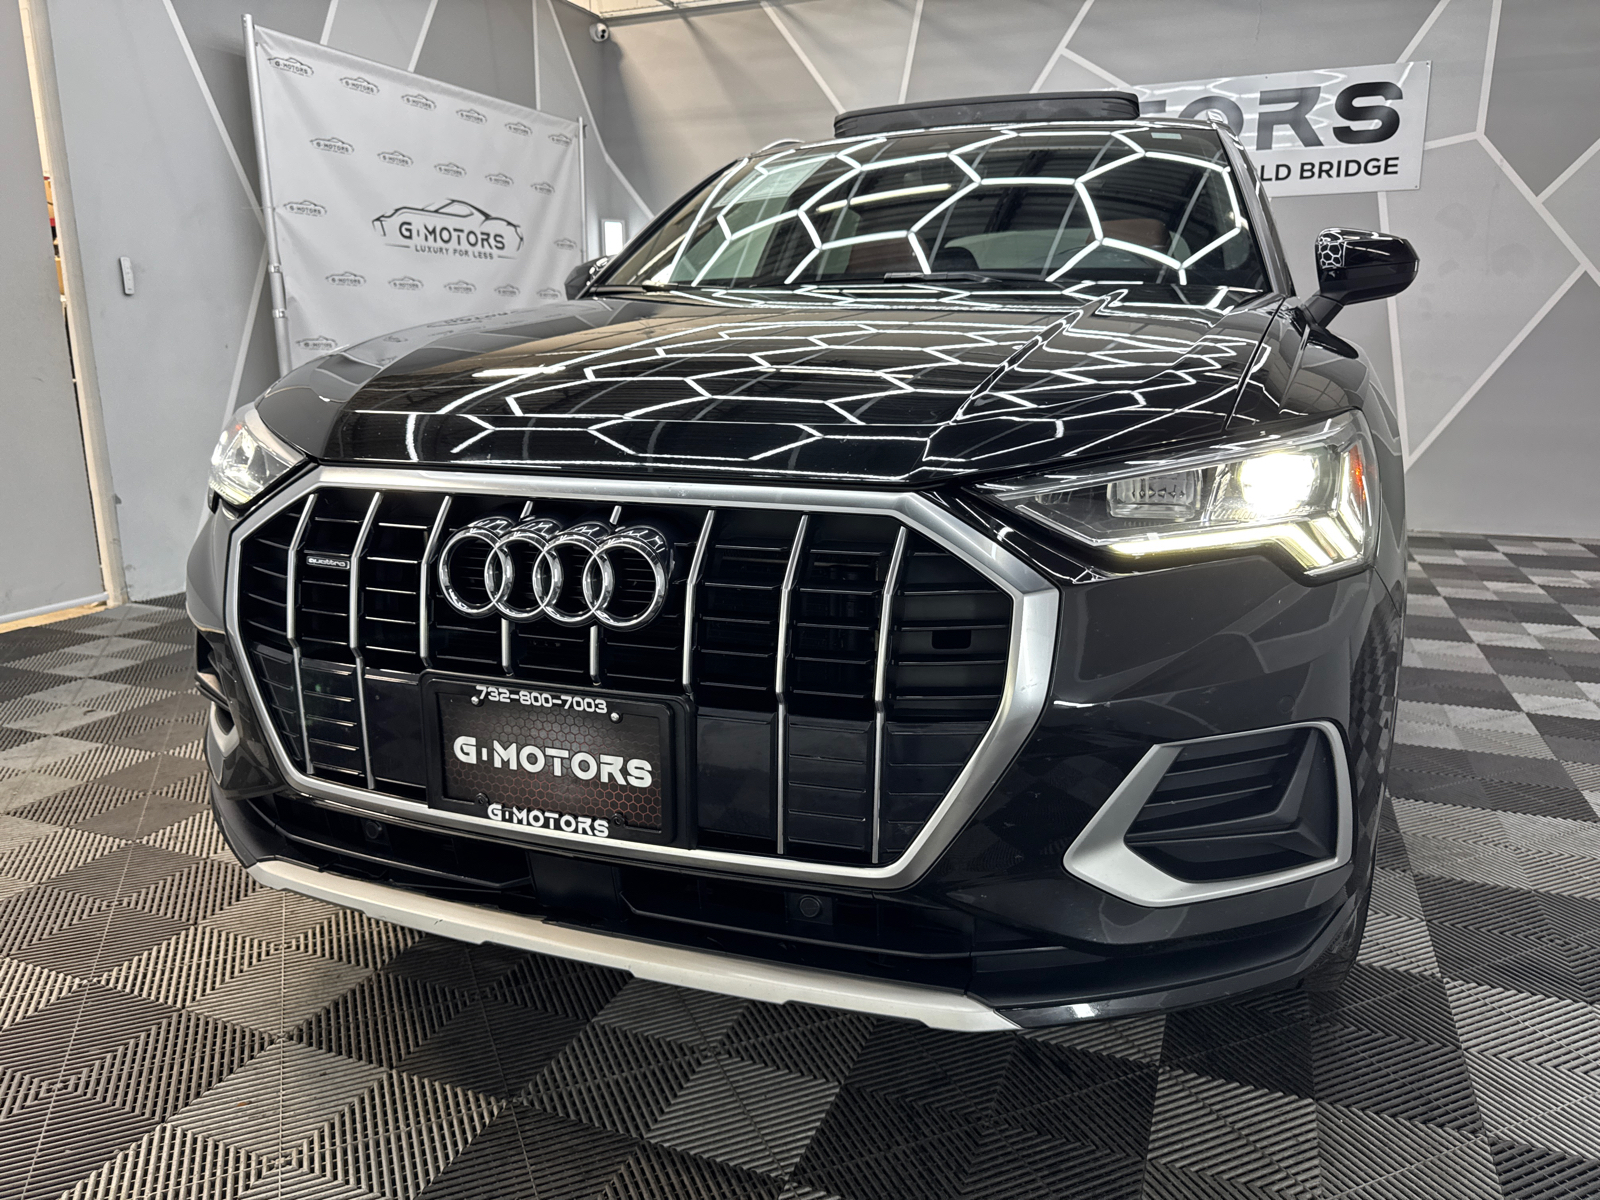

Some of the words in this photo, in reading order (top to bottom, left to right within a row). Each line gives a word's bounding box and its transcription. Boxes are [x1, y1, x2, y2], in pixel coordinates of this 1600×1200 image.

[1299, 156, 1400, 180] BRIDGE
[414, 244, 450, 256] LUXURY
[453, 249, 470, 258] FOR
[472, 249, 494, 260] LESS
[308, 558, 346, 567] quattro
[475, 685, 608, 714] 732-800-7003
